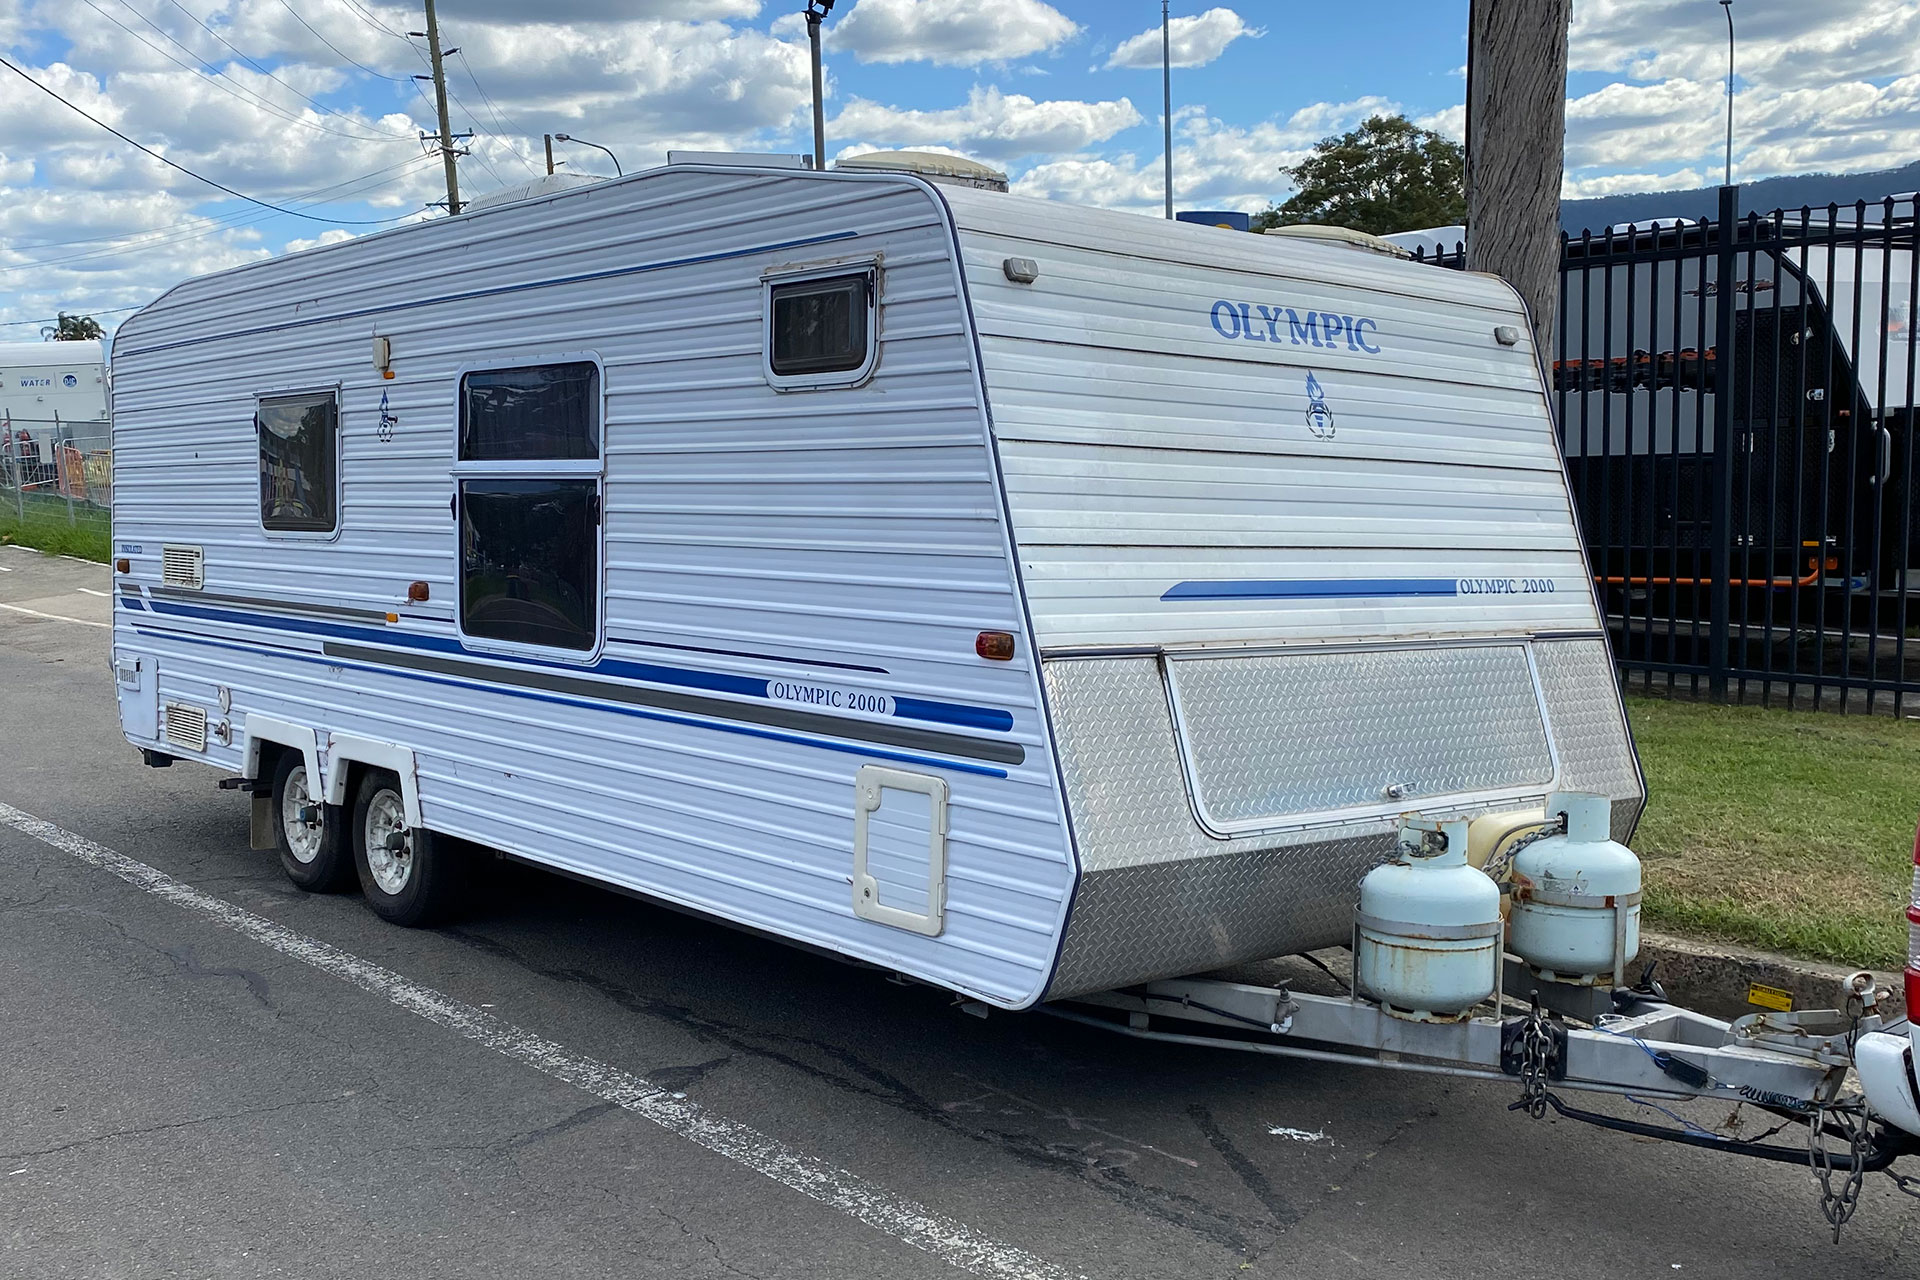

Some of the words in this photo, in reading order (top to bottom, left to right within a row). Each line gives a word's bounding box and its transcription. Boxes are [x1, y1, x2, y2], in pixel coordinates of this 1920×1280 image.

[1210, 300, 1381, 354] OLYMPIC
[20, 379, 51, 387] WATER
[1460, 579, 1517, 594] OLYMPIC
[1522, 579, 1555, 593] 2000
[774, 682, 841, 708] OLYMPIC
[848, 692, 886, 714] 2000
